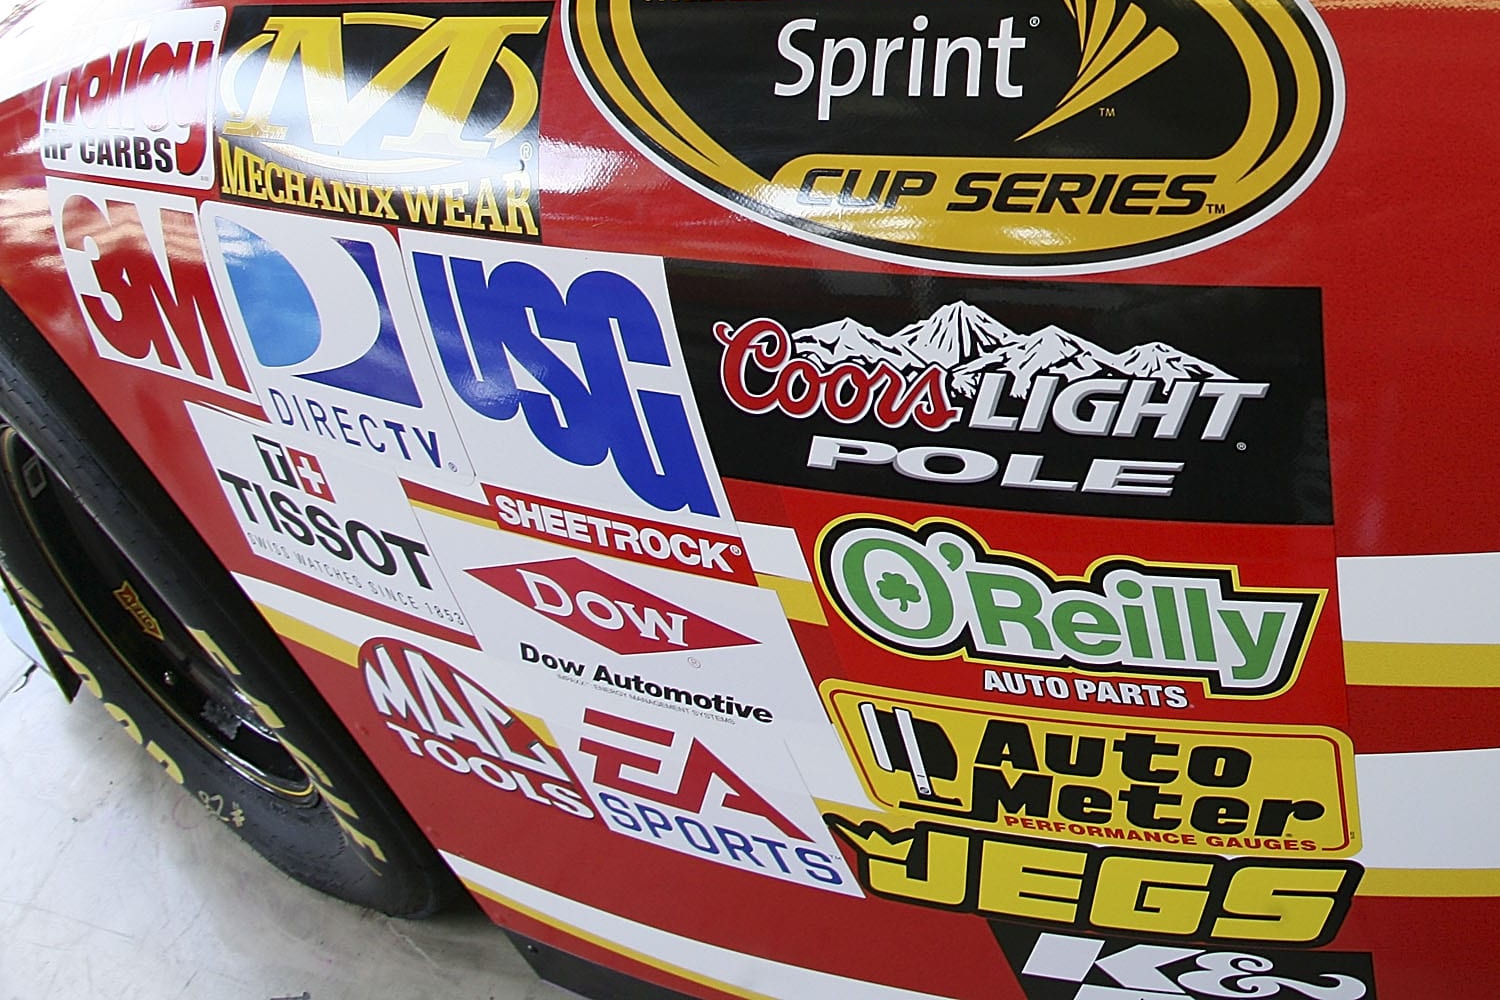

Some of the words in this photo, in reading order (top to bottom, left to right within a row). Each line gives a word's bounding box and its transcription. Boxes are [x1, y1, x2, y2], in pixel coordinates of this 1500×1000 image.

[773, 15, 1028, 121] Sprint
[79, 133, 174, 174] CARBS
[217, 136, 400, 221] MECHANIX
[402, 170, 540, 236] WEAR
[795, 166, 938, 213] CUP
[946, 172, 1217, 216] SERIES
[60, 193, 254, 393] 3M
[411, 251, 721, 518] USG
[712, 317, 962, 432] Coors
[967, 376, 1271, 441] LIGHT
[269, 387, 441, 471] DIRECTV
[804, 435, 1185, 496] POLE
[218, 469, 434, 591] TISSOT
[497, 494, 728, 573] SHEETROCK
[247, 532, 291, 560] SWISS
[294, 551, 363, 590] WATCHES
[367, 579, 419, 611] SINCE
[424, 601, 466, 627] 1853
[514, 568, 690, 646] DOW
[840, 534, 1288, 681] O'Reilly
[360, 642, 573, 784] MAC
[519, 641, 586, 678] Dow
[592, 664, 775, 724] Automotive
[984, 669, 1070, 702] AUTO
[1074, 678, 1189, 709] PARTS
[400, 722, 597, 820] TOOLS
[578, 706, 813, 844] EA
[973, 719, 1254, 788] Auto
[597, 791, 843, 887] SPORTS
[972, 767, 1326, 838] Meter
[1003, 814, 1198, 847] PERFORMANCE
[1204, 835, 1317, 852] GAUGES
[845, 824, 1352, 945] JEGS
